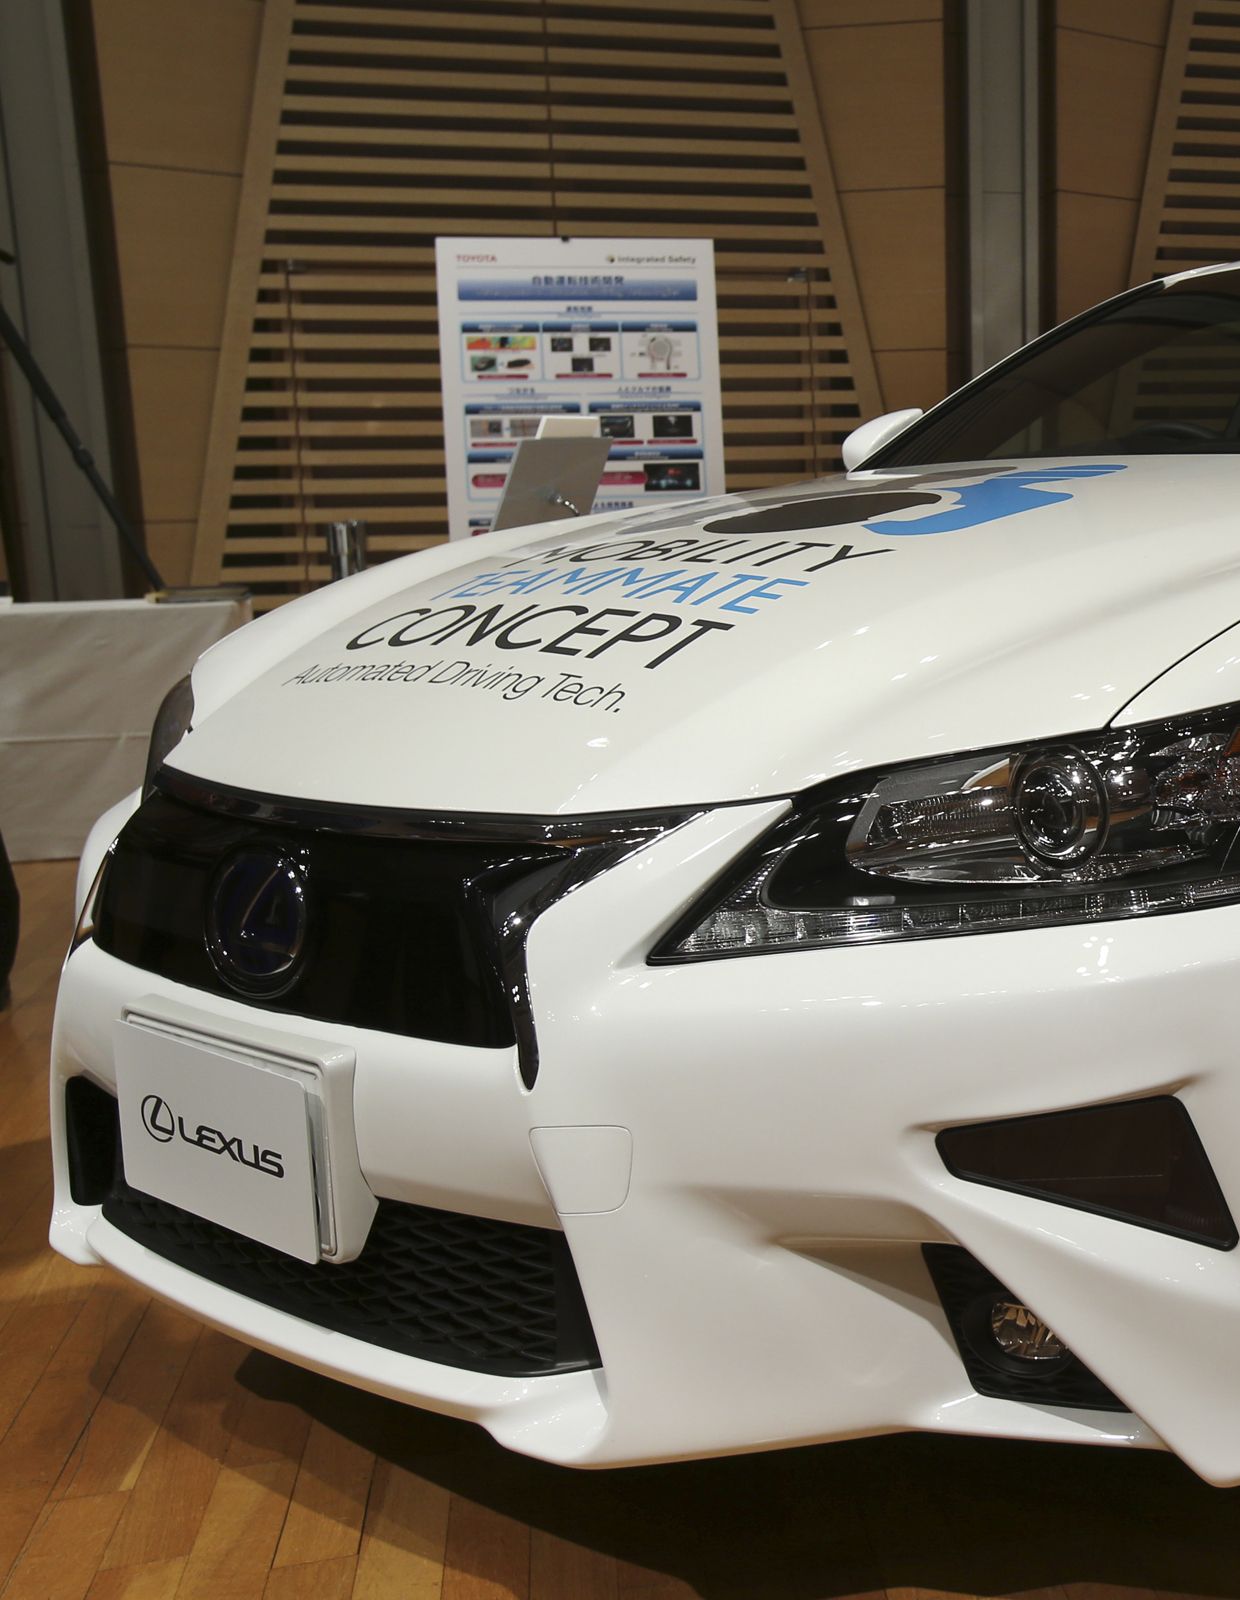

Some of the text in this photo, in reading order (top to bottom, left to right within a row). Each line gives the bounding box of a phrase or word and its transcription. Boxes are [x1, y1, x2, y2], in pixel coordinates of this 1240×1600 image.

[456, 254, 497, 263] TOYOTA
[617, 255, 696, 264] Integrated Safety
[501, 539, 897, 573] MOBILITY
[429, 567, 810, 615] TEAMMATE
[345, 603, 737, 670] CONCEPT
[281, 660, 628, 713] Automated Driving Tech.
[177, 1116, 285, 1179] LEXUS
